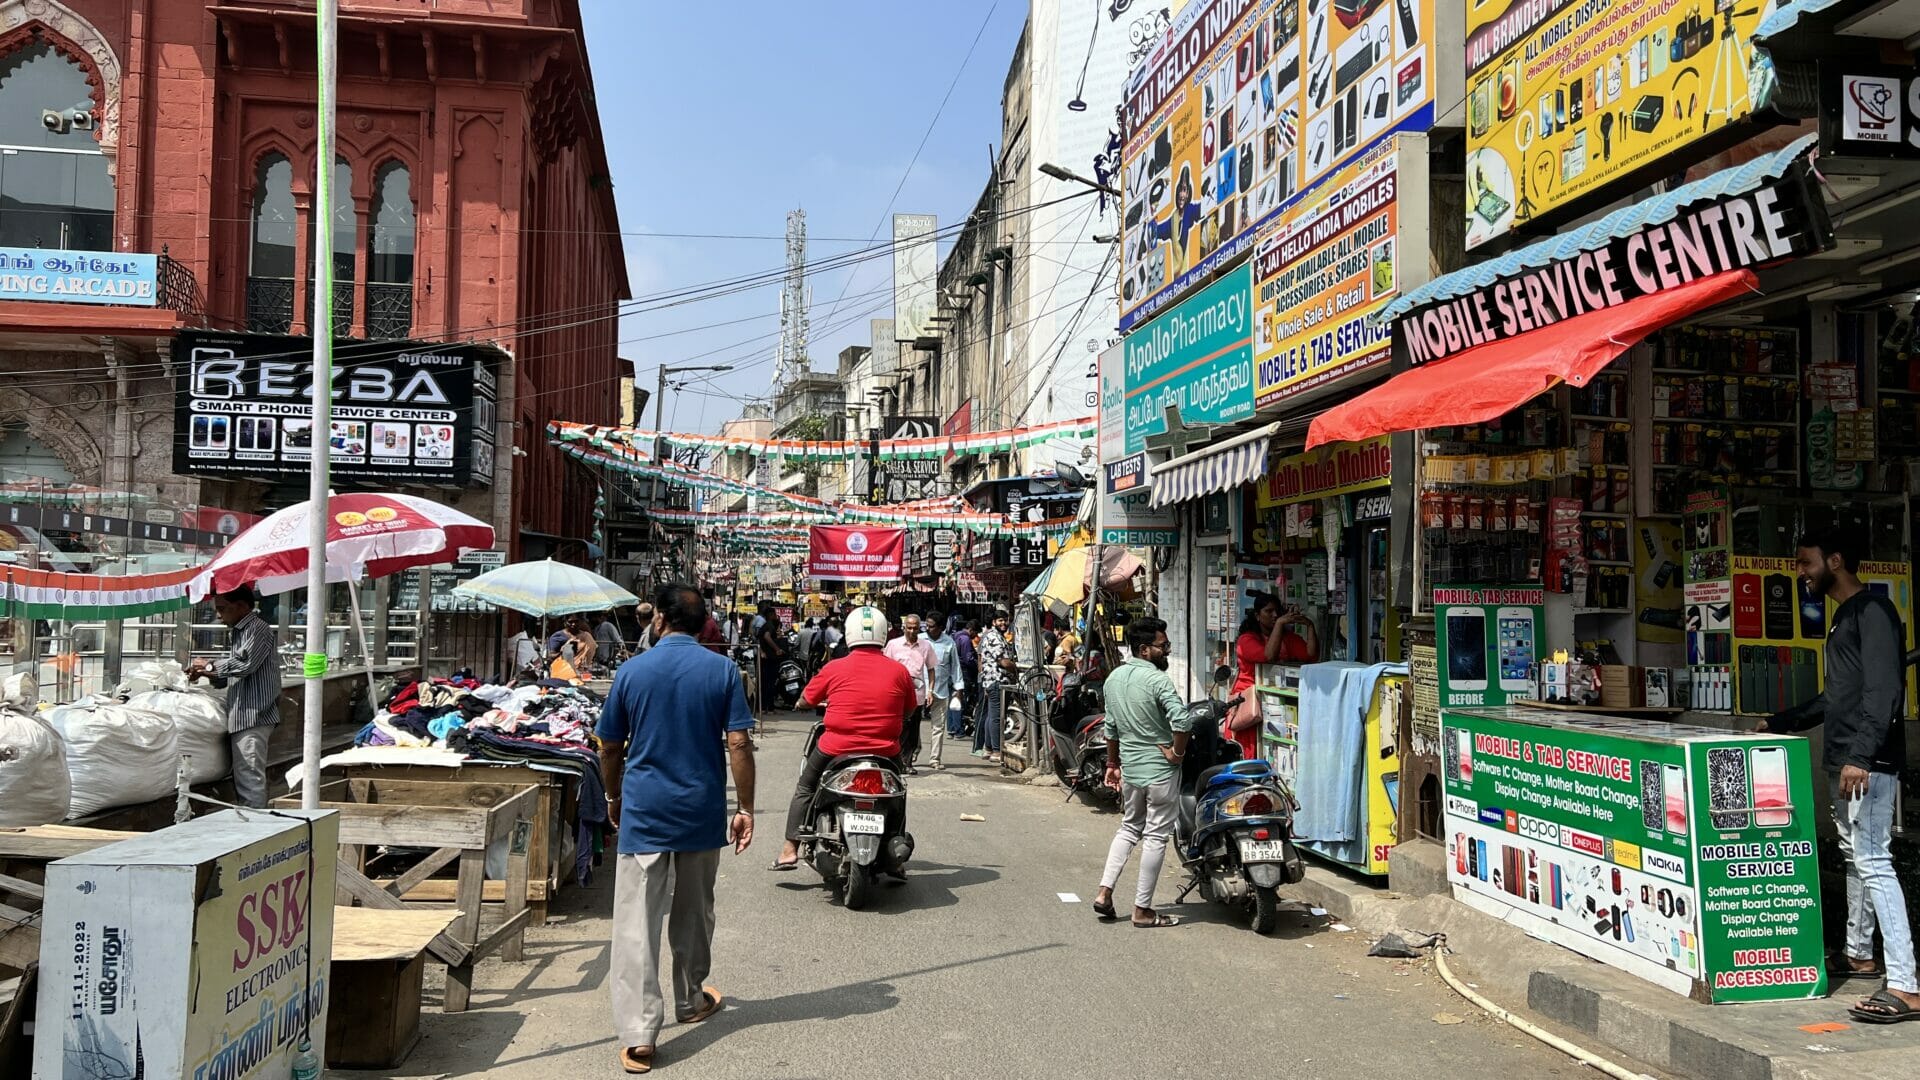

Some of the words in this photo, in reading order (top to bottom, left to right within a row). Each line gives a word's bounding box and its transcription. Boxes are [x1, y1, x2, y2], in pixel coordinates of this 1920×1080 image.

[1472, 34, 1490, 69] ALL
[1493, 0, 1548, 54] BRANDED
[1524, 42, 1538, 64] ALL
[1541, 19, 1573, 54] MOBILE
[1135, 81, 1154, 127] JAI
[1157, 28, 1200, 104] HELLO
[1857, 132, 1888, 140] MOBILE
[1266, 251, 1279, 274] JAI
[1281, 231, 1311, 262] HELLO
[1313, 212, 1341, 245] INDIA
[1343, 177, 1394, 226] MOBILES
[1189, 270, 1202, 285] Near
[1202, 260, 1215, 276] Govt
[1216, 247, 1235, 266] Estate
[1236, 234, 1253, 254] Metro
[1261, 281, 1275, 303] OUR
[1276, 269, 1295, 295] SHOP
[1296, 244, 1336, 283] AVAILABLE
[1338, 236, 1351, 260] ALL
[1353, 213, 1388, 251] MOBILE
[0, 275, 48, 293] ING
[51, 276, 152, 298] ARCADE
[1276, 272, 1326, 315] ACCESSORIES
[1327, 271, 1334, 288] &
[1335, 249, 1368, 283] SPARES
[1402, 293, 1497, 364] MOBILE
[1495, 248, 1624, 336] SERVICE
[1627, 187, 1793, 294] CENTRE
[1276, 316, 1302, 342] Whole
[1303, 306, 1323, 330] Sale
[1326, 298, 1333, 318] &
[1336, 281, 1365, 312] Retail
[1128, 289, 1247, 382] ApolloPharmacy
[1258, 348, 1296, 390] MOBILE
[1300, 343, 1307, 373] &
[1311, 331, 1333, 368] TAB
[1336, 313, 1392, 358] SERVICE
[190, 348, 451, 404] REZBA
[1190, 351, 1250, 412] மருந்தகம்
[197, 401, 254, 412] SMART
[258, 404, 313, 415] PHONE
[331, 407, 385, 418] ERVICE
[389, 411, 451, 420] CENTER
[1101, 388, 1123, 419] Apollo
[1219, 405, 1237, 419] MOUNT
[1237, 401, 1251, 414] ROAD
[886, 460, 905, 474] SALES
[913, 460, 939, 474] SERVICE
[1110, 462, 1122, 480] LAB
[1122, 456, 1141, 475] TESTS
[1269, 465, 1299, 500] Hello
[1301, 459, 1337, 493] India
[1338, 442, 1392, 487] Mobile
[1365, 496, 1392, 518] SERV
[385, 519, 408, 529] INDIA
[1107, 531, 1173, 545] CHEMIST
[813, 563, 838, 571] TRADERS
[839, 564, 864, 572] WELFARE
[864, 564, 900, 572] ASSOCIATION
[867, 554, 883, 562] ROAD
[1734, 557, 1750, 570] ALL
[1751, 558, 1782, 571] MOBILE
[1858, 562, 1907, 575] WHOLESALE
[1434, 588, 1471, 605] MOBILE
[1473, 590, 1480, 605] &
[1482, 589, 1501, 605] TAB
[1503, 589, 1544, 605] SERVICE
[1448, 693, 1484, 705] BEFORE
[1475, 733, 1521, 761] MOBILE
[1523, 741, 1533, 762] &
[1536, 743, 1563, 768] TAB
[1567, 749, 1633, 783] SERVICE
[1473, 759, 1501, 777] Software
[1502, 764, 1510, 777] IC
[1512, 767, 1544, 787] Change,
[1545, 774, 1573, 793] Mother
[1575, 780, 1600, 799] Board
[1601, 786, 1642, 810] Change,
[1494, 781, 1520, 801] Display
[1521, 787, 1551, 808] Change
[1553, 795, 1591, 817] Available
[1593, 806, 1614, 822] Here
[1267, 841, 1278, 849] 01
[1455, 798, 1476, 817] iPhone
[1481, 808, 1502, 822] SAMSUNG
[1519, 816, 1558, 839] oppo
[1573, 837, 1601, 850] ONEPLUS
[1615, 847, 1639, 862] realme
[1647, 855, 1684, 875] NOKIA
[1244, 851, 1257, 860] BB
[1259, 850, 1282, 859] 3544
[1702, 844, 1760, 861] MOBILE
[1766, 843, 1776, 857] &
[1780, 841, 1812, 856] TAB
[1727, 861, 1794, 878] SERVICE
[1708, 885, 1749, 897] Software
[1752, 884, 1763, 895] IC
[1765, 884, 1808, 895] Change,
[1705, 900, 1740, 912] Mother
[1742, 898, 1771, 910] Board
[1773, 897, 1816, 909] Change,
[232, 862, 313, 974] SSK
[1721, 913, 1757, 926] Display
[1759, 911, 1800, 924] Change
[1727, 926, 1773, 938] Available
[1775, 925, 1799, 936] Here
[1734, 948, 1791, 966] MOBILE
[73, 921, 86, 1020] 11-11-2022
[225, 942, 310, 1015] ELECTRONICS
[1715, 967, 1819, 988] ACCESSORIES
